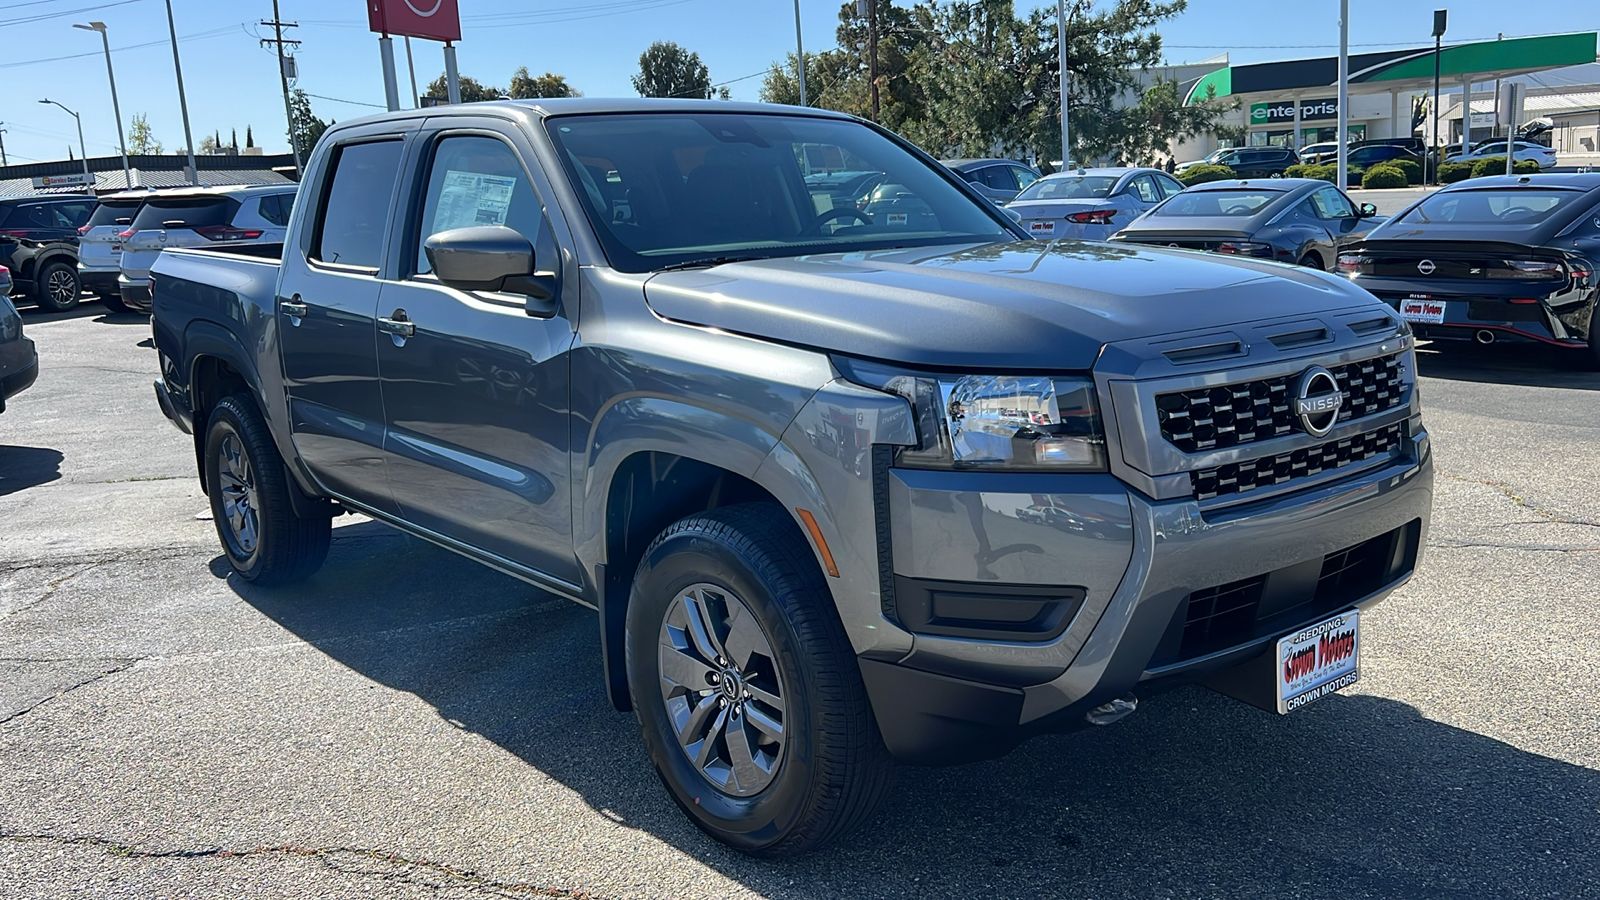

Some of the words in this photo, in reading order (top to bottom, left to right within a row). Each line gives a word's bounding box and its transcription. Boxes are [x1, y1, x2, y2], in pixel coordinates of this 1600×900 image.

[1251, 102, 1338, 119] entepris
[1299, 619, 1341, 642] REDDING
[1284, 644, 1316, 684] Crown
[1318, 629, 1355, 669] Motors
[1287, 690, 1320, 711] CROWN
[1321, 672, 1357, 696] MOTORS
